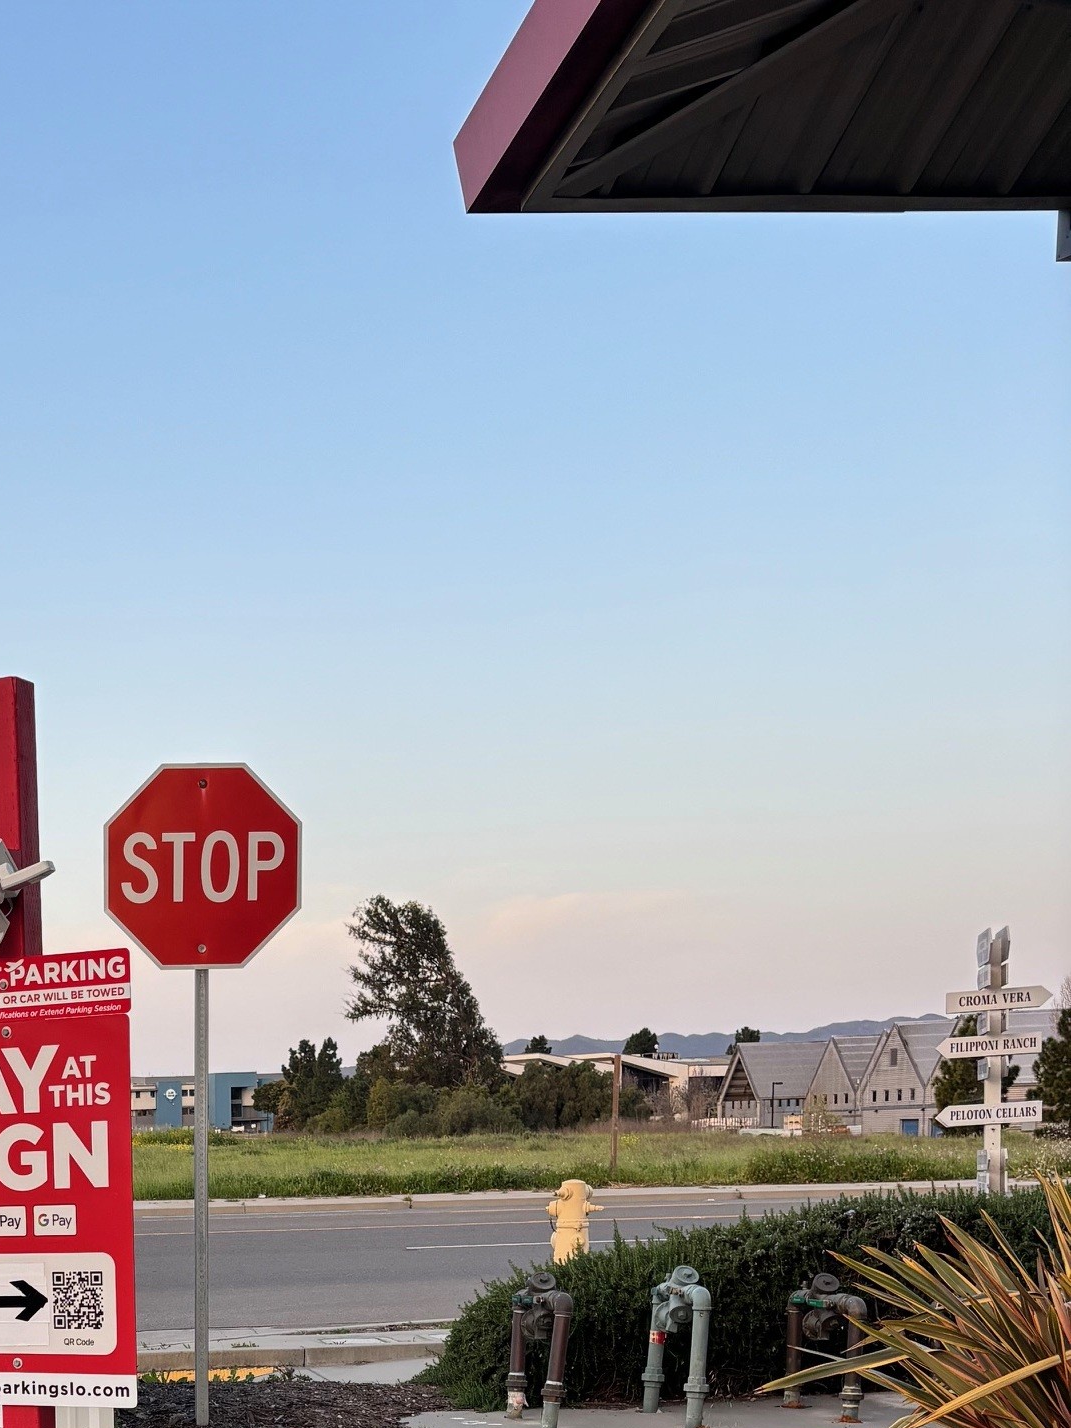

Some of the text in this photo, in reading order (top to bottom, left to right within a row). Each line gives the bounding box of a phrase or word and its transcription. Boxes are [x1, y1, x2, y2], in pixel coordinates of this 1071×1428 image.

[121, 830, 286, 904] STOP
[9, 956, 126, 988] PARKING
[2, 995, 17, 1005] OR
[20, 993, 41, 1004] CAR
[43, 991, 69, 1001] WILL
[71, 990, 84, 1000] BE
[87, 987, 125, 998] TOWED
[958, 991, 1031, 1007] CROMA VERA
[39, 1007, 65, 1016] Extend
[65, 1005, 94, 1015] Parking
[94, 1003, 122, 1012] Session
[949, 1037, 1037, 1053] FILIPPONI RANCH
[61, 1054, 97, 1080] AT
[48, 1082, 111, 1108] THIS
[949, 1106, 1037, 1121] PELOTON CELLARS
[0, 1214, 22, 1230] Pay
[38, 1213, 73, 1229] G Pay
[63, 1337, 95, 1346] QR Code
